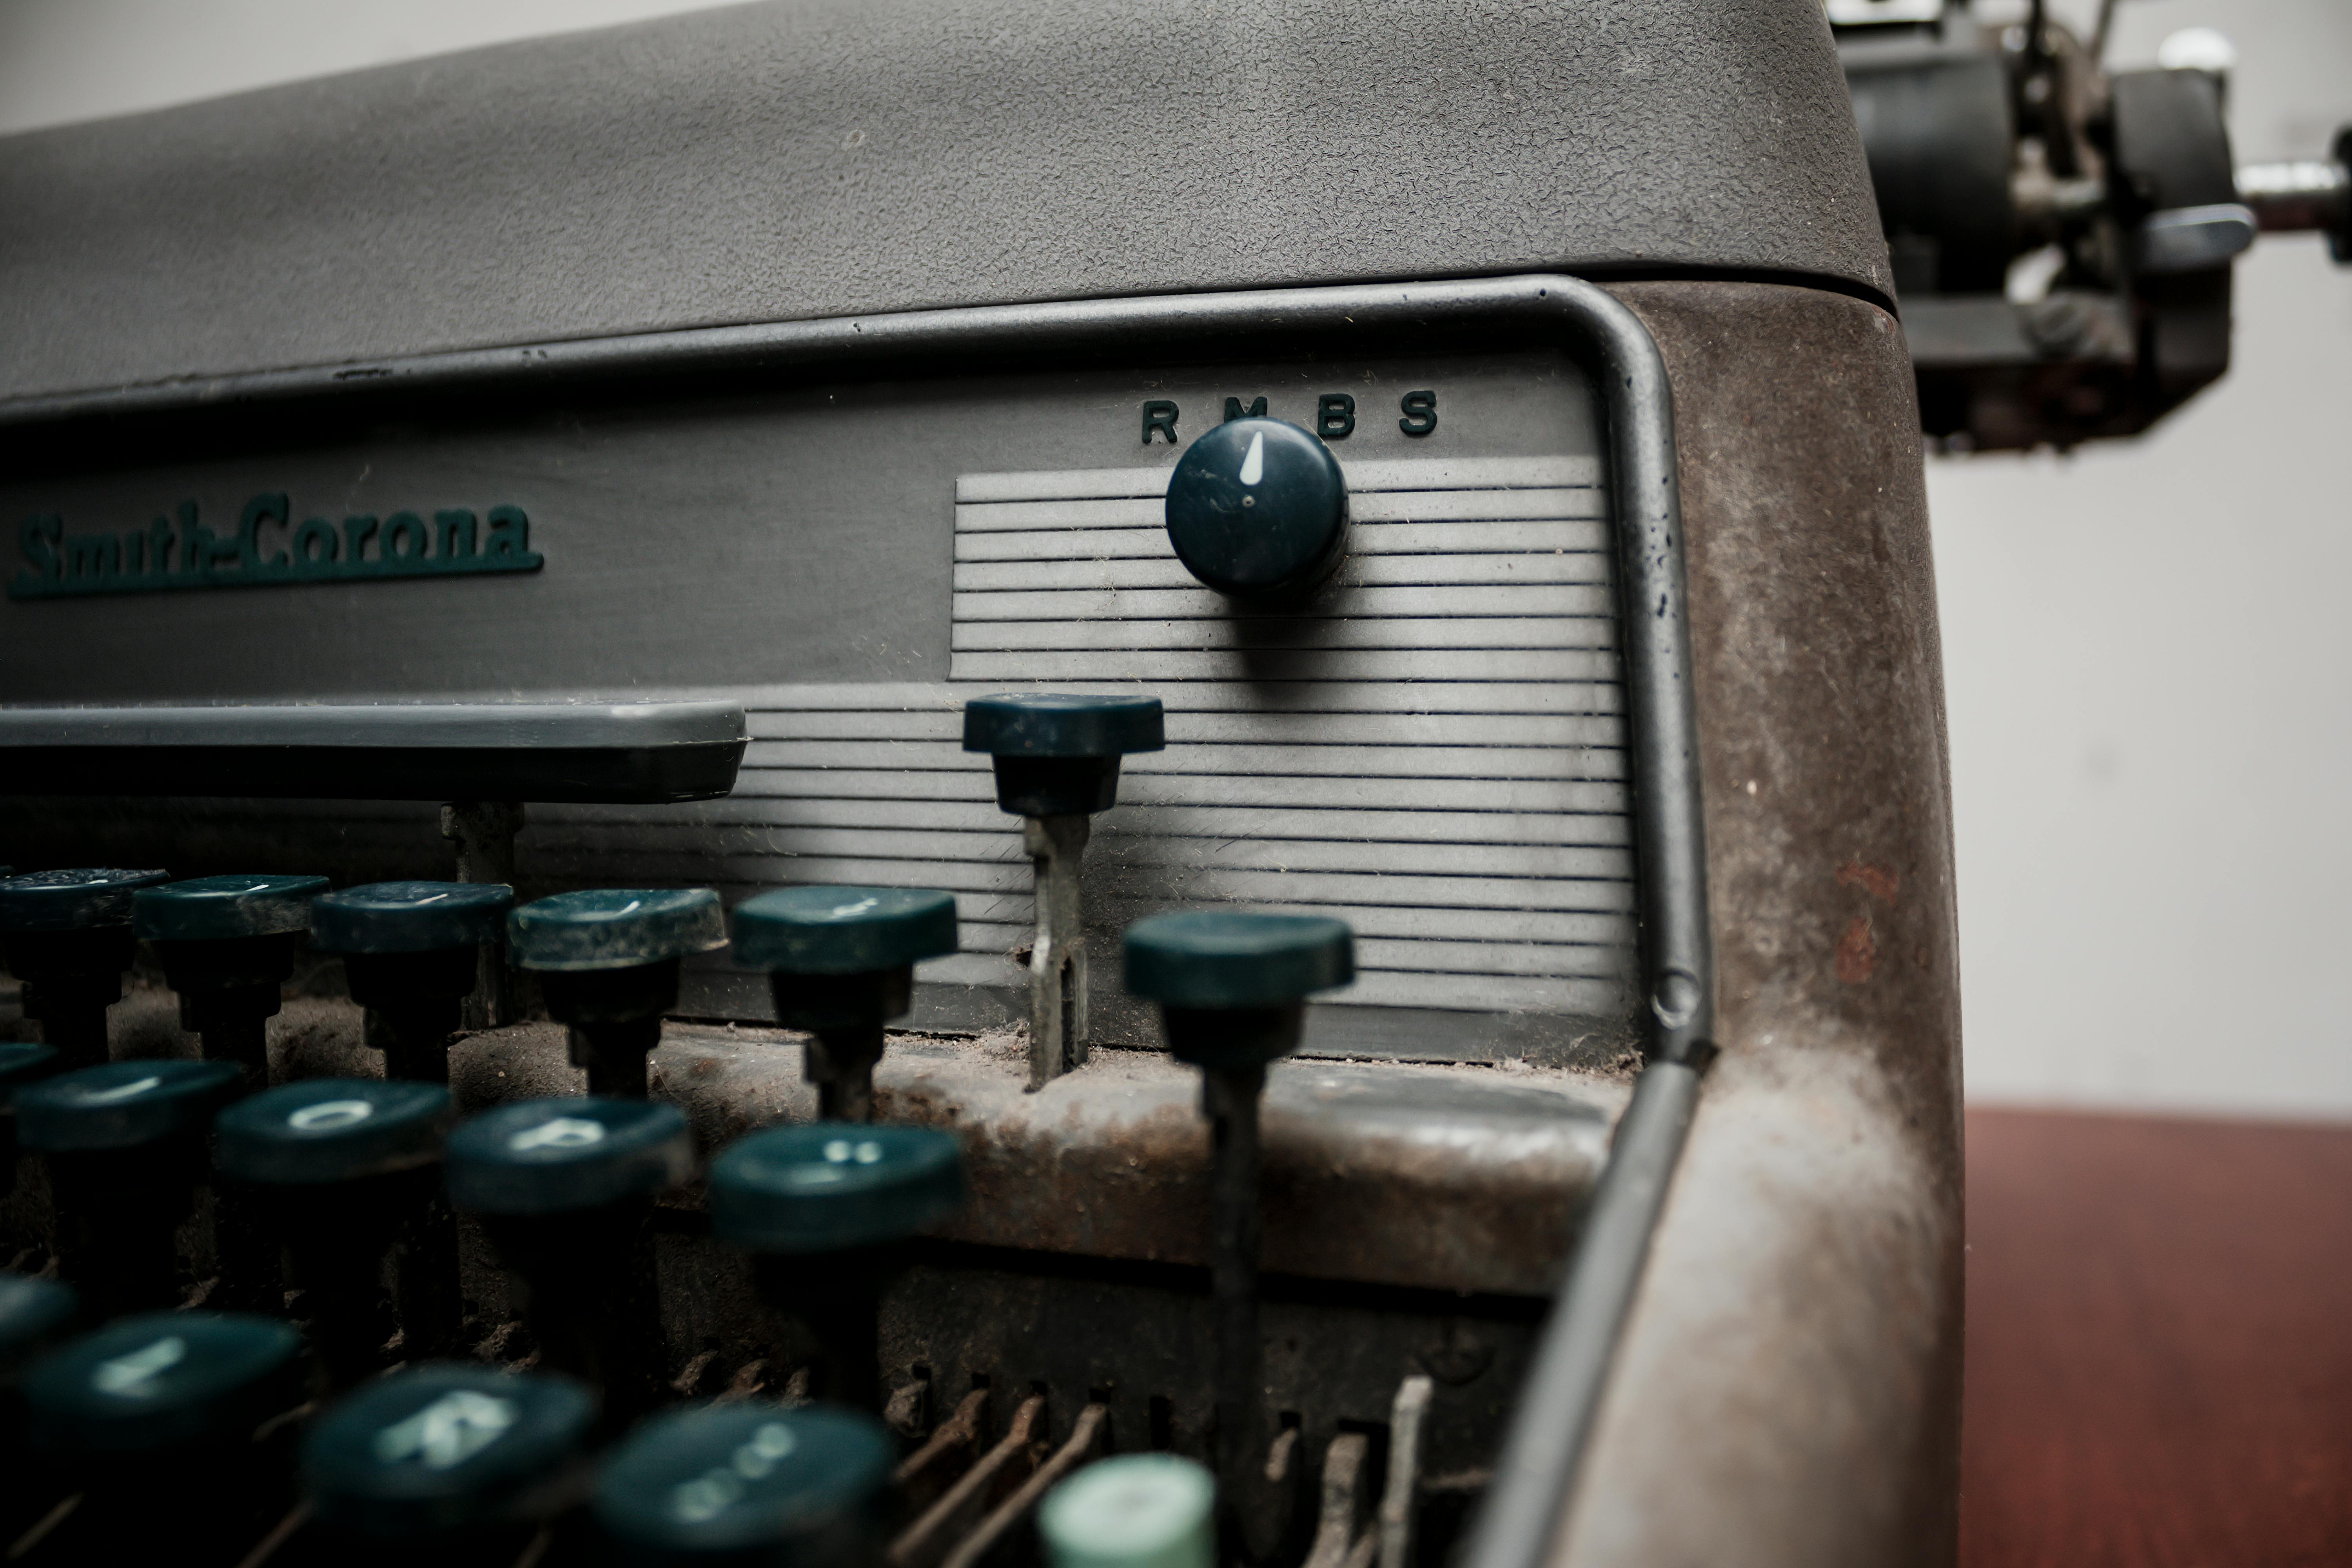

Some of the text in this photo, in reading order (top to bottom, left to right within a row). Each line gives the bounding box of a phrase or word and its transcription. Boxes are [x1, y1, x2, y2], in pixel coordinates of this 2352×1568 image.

[1142, 390, 1438, 444] R M B S
[8, 492, 544, 600] Smith-Corona
